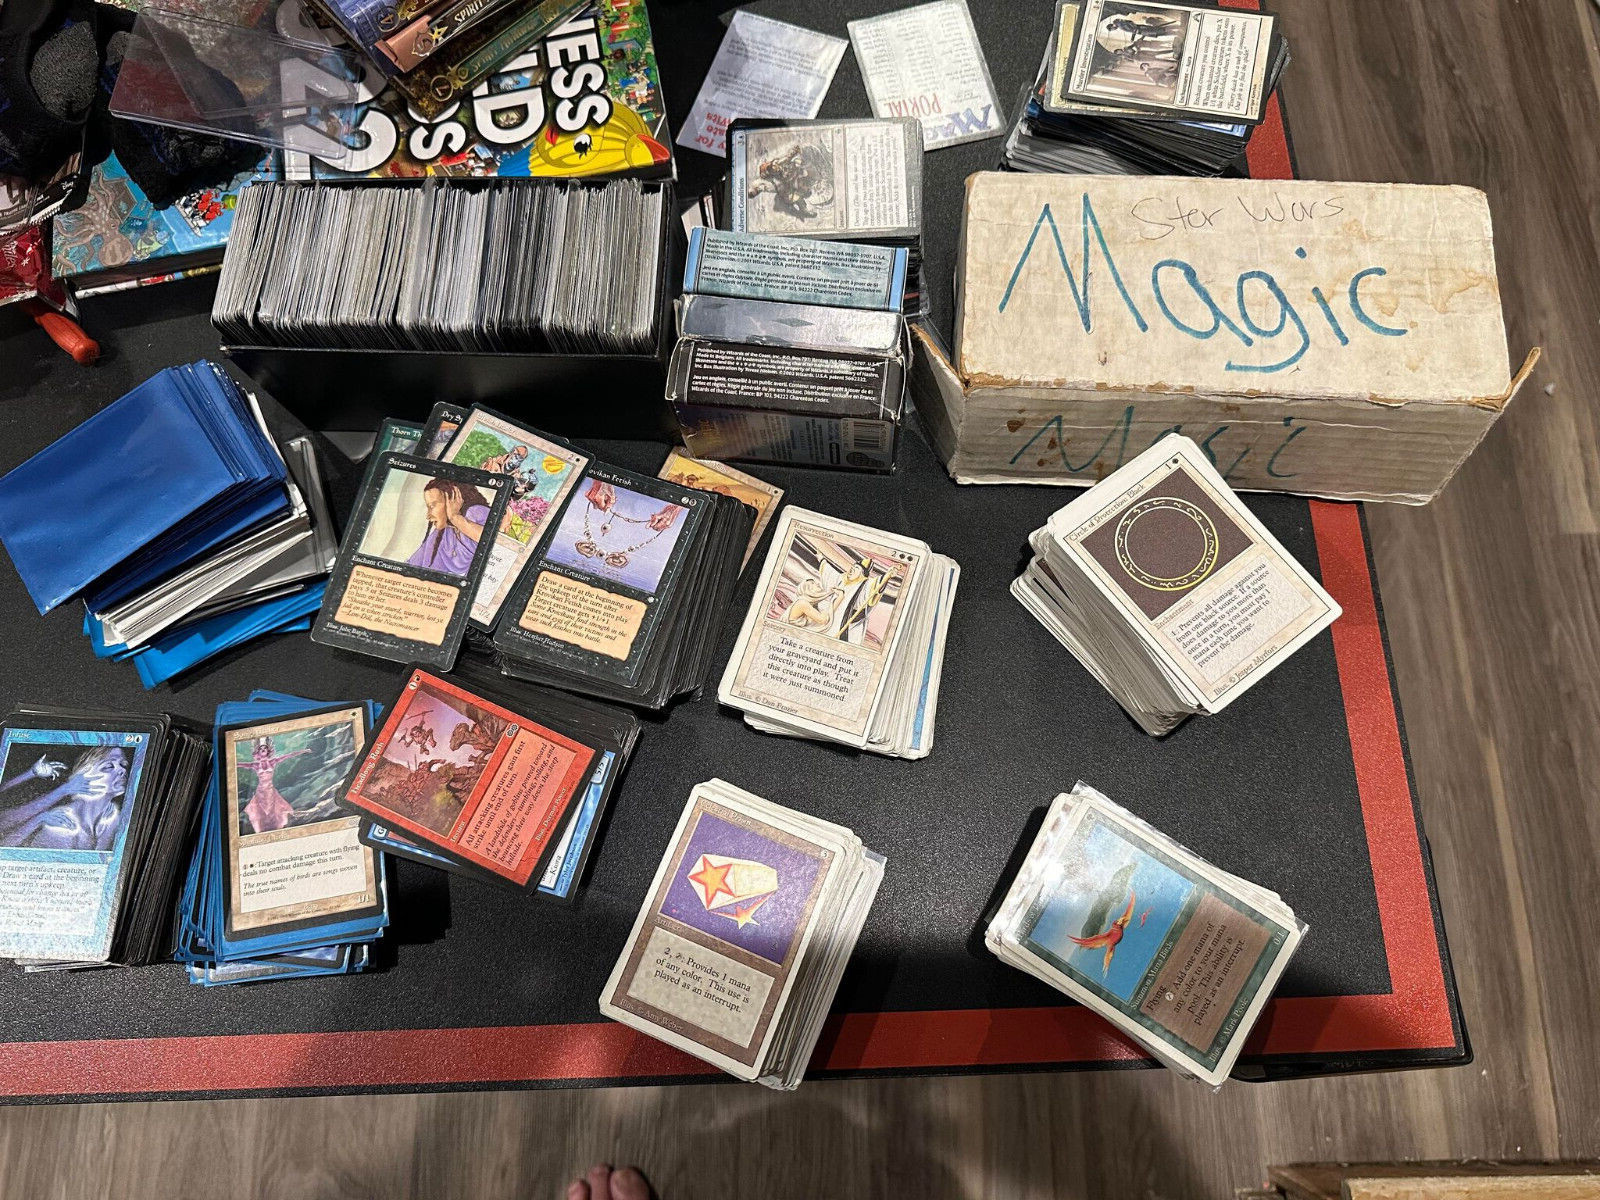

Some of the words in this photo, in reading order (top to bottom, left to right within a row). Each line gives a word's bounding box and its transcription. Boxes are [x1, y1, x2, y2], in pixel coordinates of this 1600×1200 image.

[454, 1, 487, 26] SPIRIT
[1079, 33, 1093, 68] Investigation
[1075, 69, 1085, 89] Murder
[884, 92, 942, 119] PORTAL
[999, 192, 1408, 374] Magic
[391, 426, 411, 436] Thorn
[1009, 405, 1307, 478] Mgic
[386, 456, 418, 470] Seizures
[609, 473, 633, 487] Fetish
[1068, 526, 1088, 541] Circle
[1087, 519, 1095, 528] of
[1093, 497, 1128, 523] Protection:
[1126, 483, 1145, 498] Black
[793, 521, 834, 538] Resurrection
[350, 553, 378, 566] Enchant
[375, 559, 404, 573] Creature
[536, 558, 565, 574] Enchant
[562, 567, 592, 583] Creature
[1175, 629, 1192, 643] from
[1190, 621, 1203, 632] one
[1200, 608, 1219, 623] black
[1218, 594, 1240, 611] source.
[1238, 586, 1247, 594] If
[1249, 569, 1269, 586] source
[1177, 610, 1204, 631] Prevents
[1203, 602, 1213, 612] all
[1211, 587, 1234, 606] damage
[1233, 571, 1255, 589] against
[1253, 562, 1266, 574] you
[761, 620, 786, 633] Sorcery
[1155, 598, 1194, 630] Enchantment
[767, 644, 785, 653] your
[785, 650, 822, 665] graveyard
[822, 661, 838, 670] and
[837, 666, 851, 675] put
[779, 636, 797, 648] Take
[804, 646, 834, 659] creature
[835, 654, 853, 665] from
[766, 661, 780, 671] this
[781, 668, 811, 681] creature
[822, 679, 848, 693] though
[767, 652, 796, 667] directly
[796, 662, 812, 671] into
[811, 667, 829, 677] play.
[834, 672, 854, 685] Treat
[769, 673, 787, 683] were
[787, 679, 802, 688] just
[7, 729, 30, 739] Infuse
[349, 759, 376, 796] Headlong
[368, 739, 387, 762] Rush
[465, 833, 475, 846] All
[472, 802, 493, 834] attacking
[490, 771, 509, 802] creatures
[507, 755, 518, 771] gain
[513, 740, 525, 755] first
[448, 818, 467, 843] Instant
[473, 829, 487, 849] strike
[484, 810, 496, 828] until
[493, 796, 504, 811] end
[501, 787, 509, 797] of
[242, 869, 258, 877] deals
[268, 863, 291, 873] combat
[291, 859, 315, 868] damage
[316, 856, 328, 864] this
[256, 859, 276, 867] Target
[276, 854, 303, 864] attacking
[303, 850, 328, 859] creature
[342, 844, 359, 852] flying
[1271, 929, 1286, 947] 0/1
[1172, 969, 1186, 990] Add
[1183, 955, 1196, 971] one
[1192, 932, 1209, 955] mana
[1203, 920, 1215, 932] of
[1173, 997, 1185, 1013] any
[1182, 976, 1197, 997] color
[1193, 965, 1203, 975] to
[1199, 946, 1214, 967] your
[1210, 924, 1227, 947] mana
[655, 958, 666, 966] of
[664, 961, 680, 973] any
[680, 969, 702, 983] color.
[708, 978, 726, 993] This
[726, 989, 741, 999] use
[741, 993, 749, 1003] is
[685, 956, 719, 978] Provides
[721, 972, 727, 981] 1
[728, 977, 751, 992] mana
[1128, 976, 1153, 1011] Summon
[1146, 956, 1165, 980] Mana
[1158, 938, 1175, 960] Birds
[1186, 992, 1202, 1014] pool.
[1197, 969, 1214, 990] This
[1210, 944, 1228, 970] ability
[1225, 936, 1233, 944] is
[653, 969, 681, 985] played
[681, 981, 691, 990] as
[691, 986, 702, 995] an
[703, 989, 741, 1012] interrupt.
[1145, 985, 1167, 1011] Flying
[1193, 997, 1212, 1026] played
[1208, 986, 1217, 998] as
[1214, 976, 1224, 987] an
